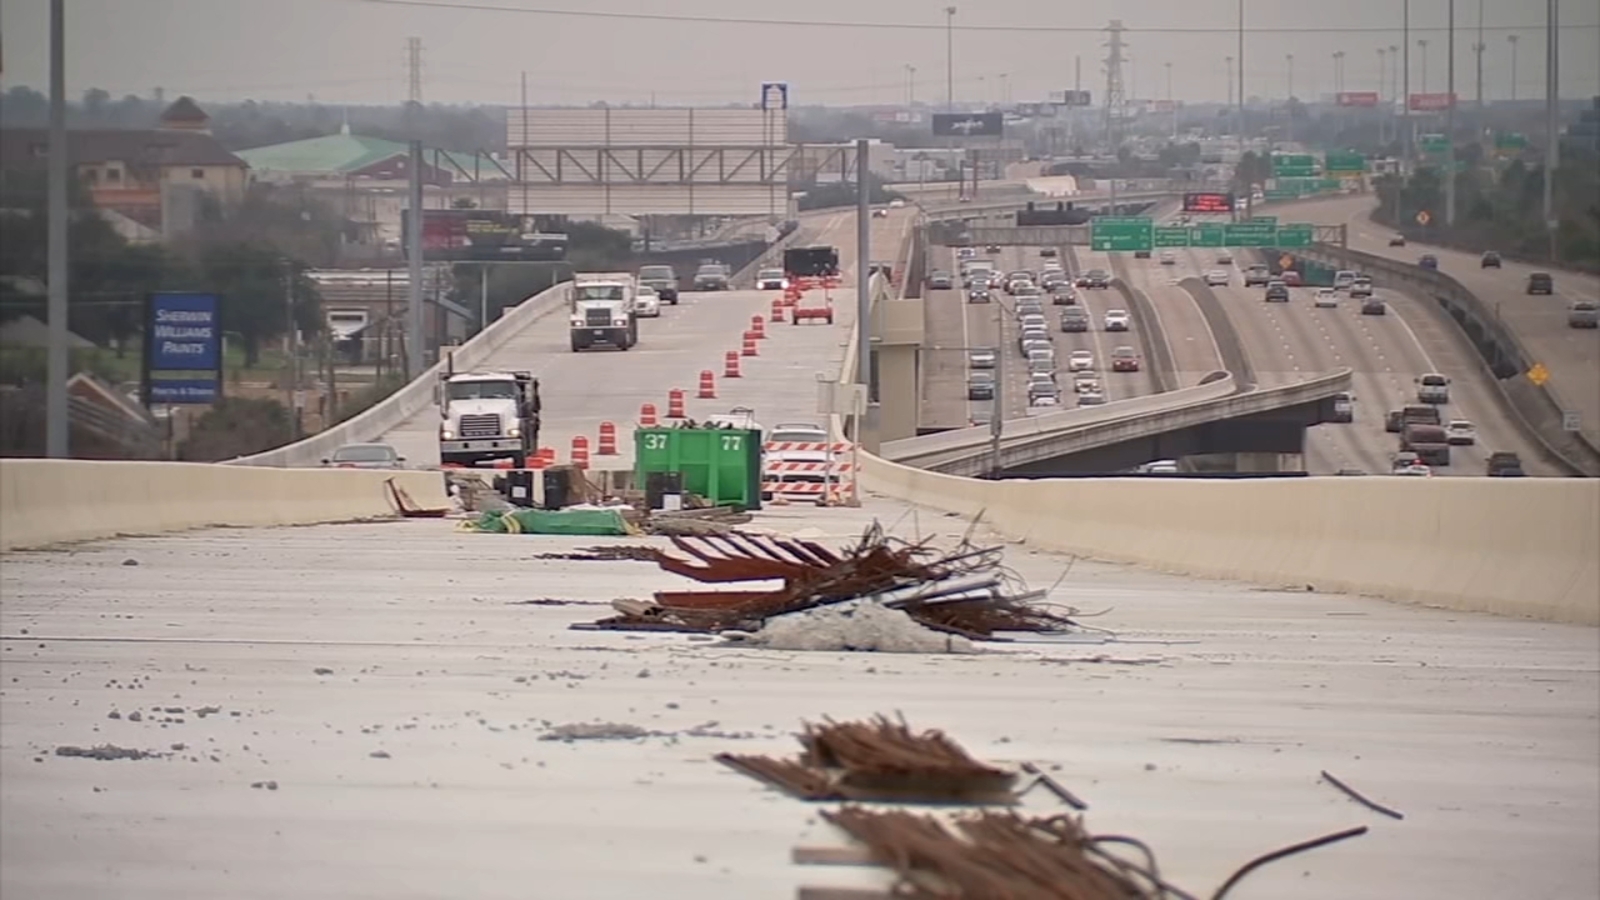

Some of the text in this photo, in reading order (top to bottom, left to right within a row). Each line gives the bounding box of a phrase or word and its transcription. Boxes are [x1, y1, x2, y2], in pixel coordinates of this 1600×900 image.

[162, 341, 205, 354] PAINTS
[644, 433, 742, 451] 37 77
